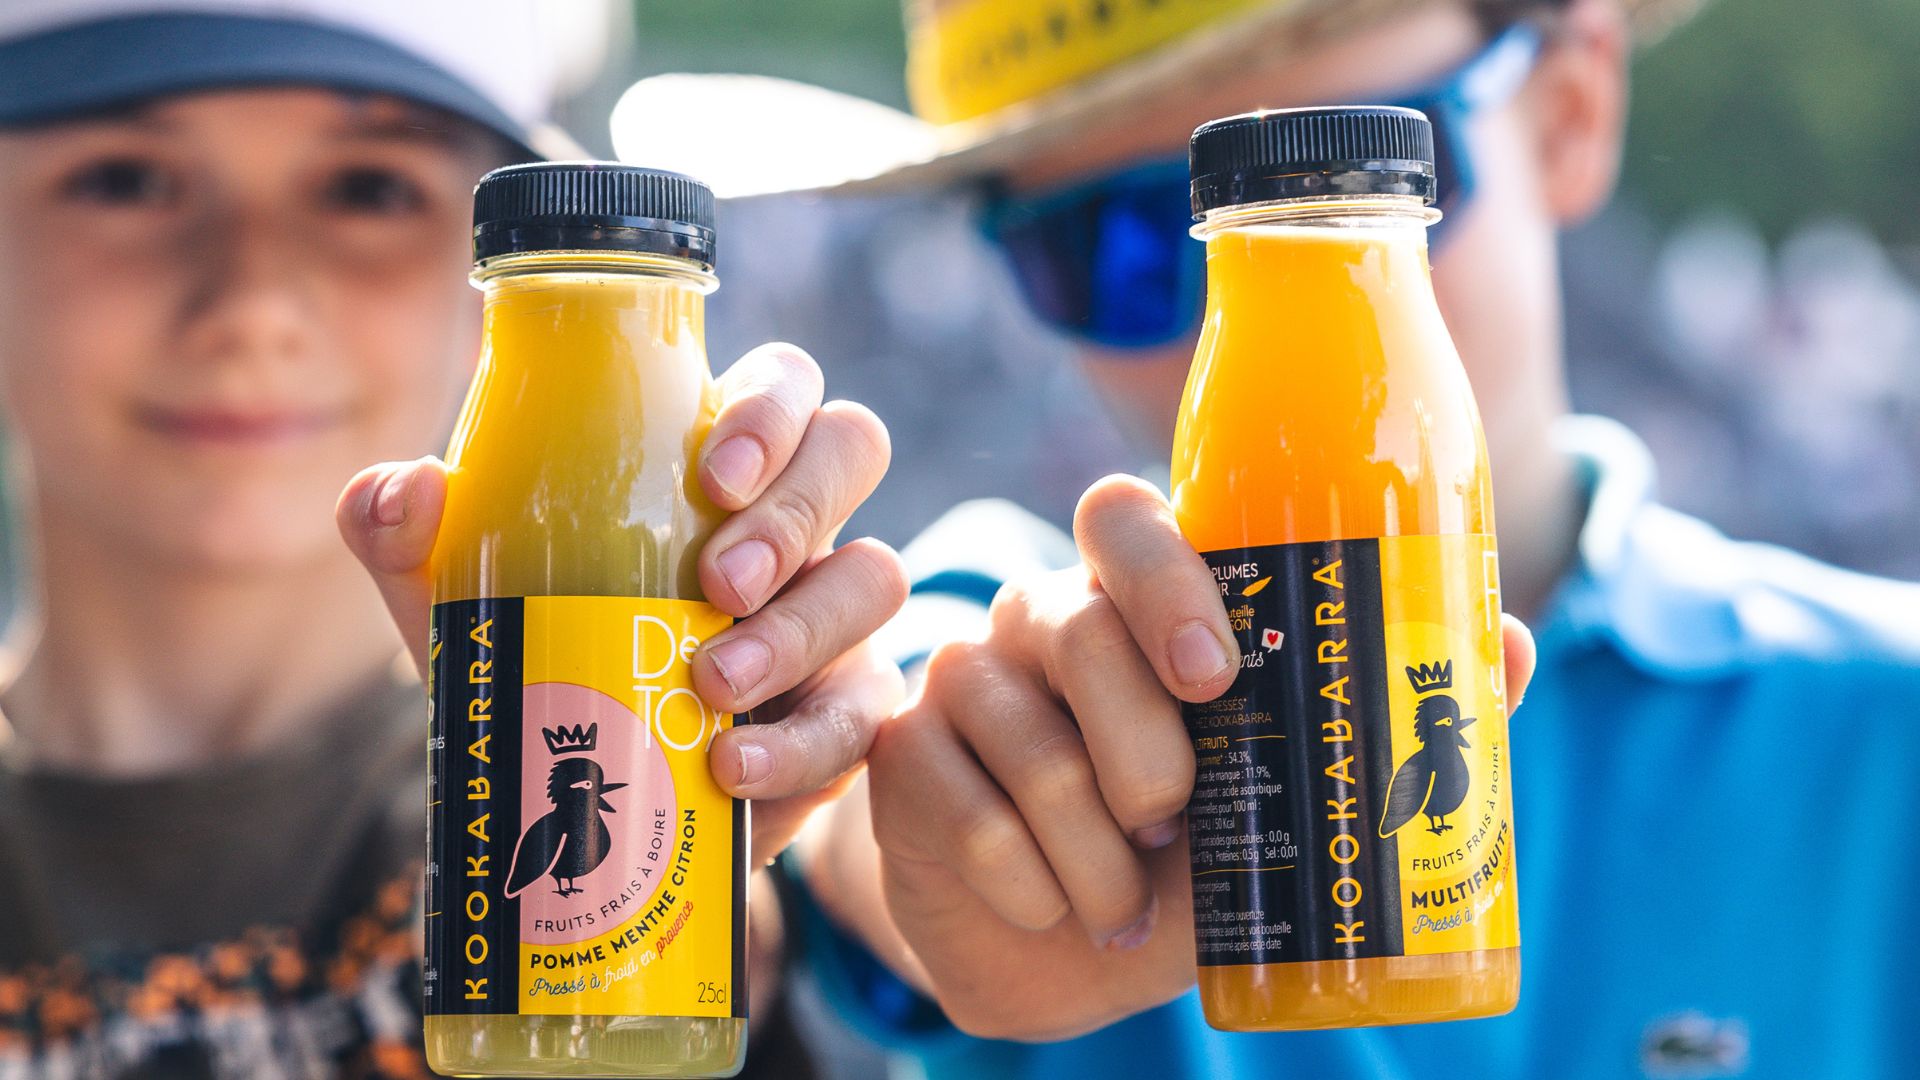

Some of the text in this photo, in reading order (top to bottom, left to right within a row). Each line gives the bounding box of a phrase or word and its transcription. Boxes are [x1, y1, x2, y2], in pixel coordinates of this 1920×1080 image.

[1211, 563, 1258, 579] PLUMES
[1228, 604, 1255, 618] uteille
[1313, 559, 1365, 944] KOOKABARRA
[1215, 770, 1241, 783] mangue
[1240, 782, 1282, 797] ascorbique
[465, 619, 493, 1000] KOOKABARRA
[1233, 800, 1246, 812] 100
[1280, 845, 1298, 860] 0,01
[1412, 848, 1464, 872] FRUITS
[1466, 813, 1491, 853] FRAIS
[534, 808, 666, 933] FRUITS FRAIS À BOIRE
[1411, 819, 1508, 909] MULTIFRUITS
[530, 809, 696, 969] POMME MENTHE CITRON
[1261, 921, 1292, 935] bouteille
[1412, 910, 1462, 935] Pressé
[1464, 907, 1473, 922] à
[529, 899, 694, 997] Pressé à froid en provence
[1266, 938, 1282, 950] date
[697, 981, 727, 1005] 25cl
